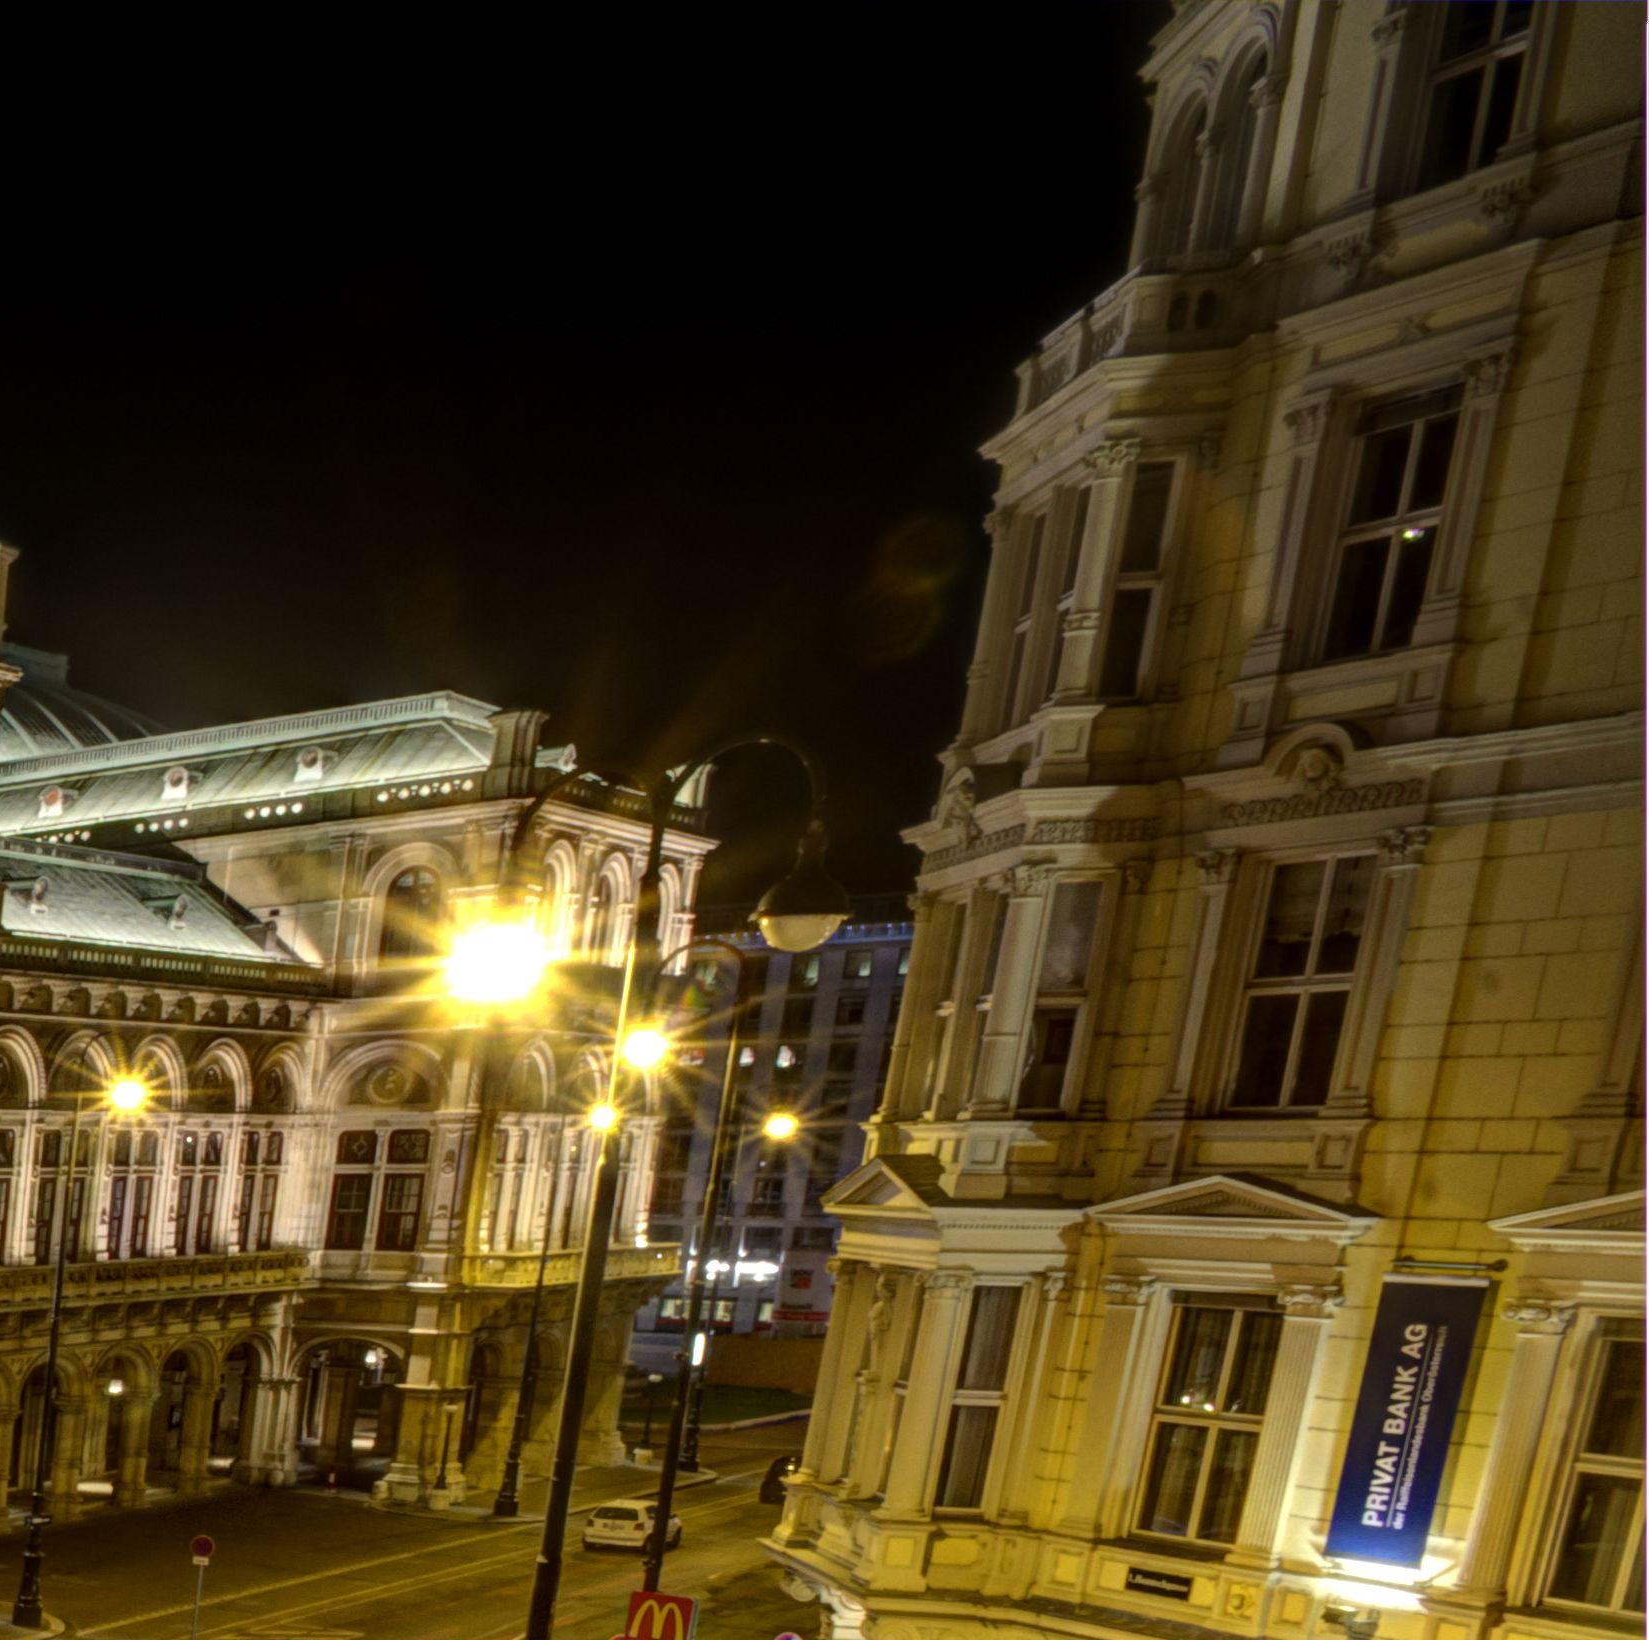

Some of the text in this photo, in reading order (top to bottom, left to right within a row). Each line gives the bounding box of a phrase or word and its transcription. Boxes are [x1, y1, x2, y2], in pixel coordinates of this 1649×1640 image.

[1361, 1323, 1428, 1528] PRIVAT BANK AG
